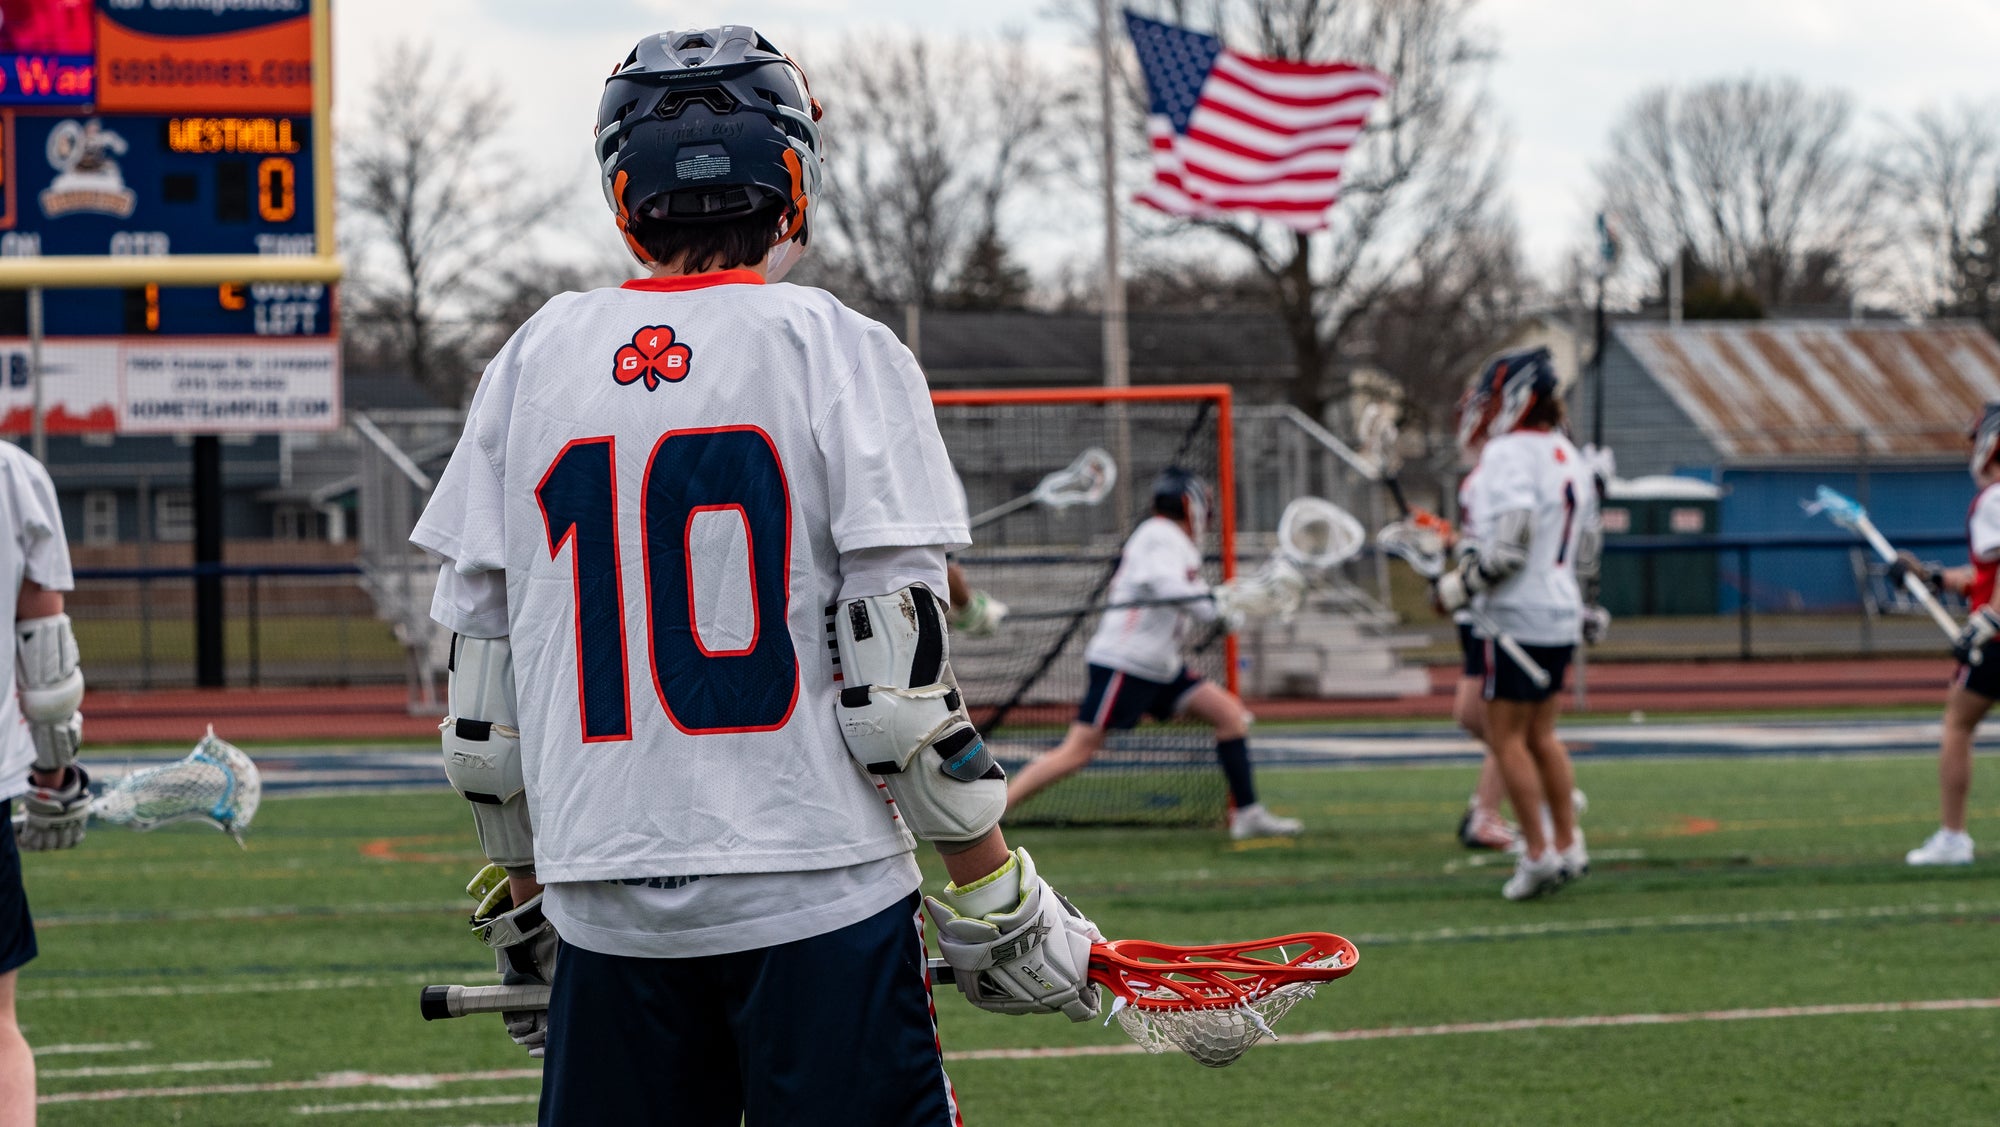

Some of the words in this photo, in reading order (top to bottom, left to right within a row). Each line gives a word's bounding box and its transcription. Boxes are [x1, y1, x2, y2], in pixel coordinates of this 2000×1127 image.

[659, 69, 724, 80] cascade
[258, 157, 295, 221] 0
[253, 302, 319, 335] LEFT
[649, 336, 658, 348] 4
[622, 356, 638, 371] G
[667, 354, 683, 368] B
[534, 424, 801, 744] 10
[990, 910, 1052, 967] STX
